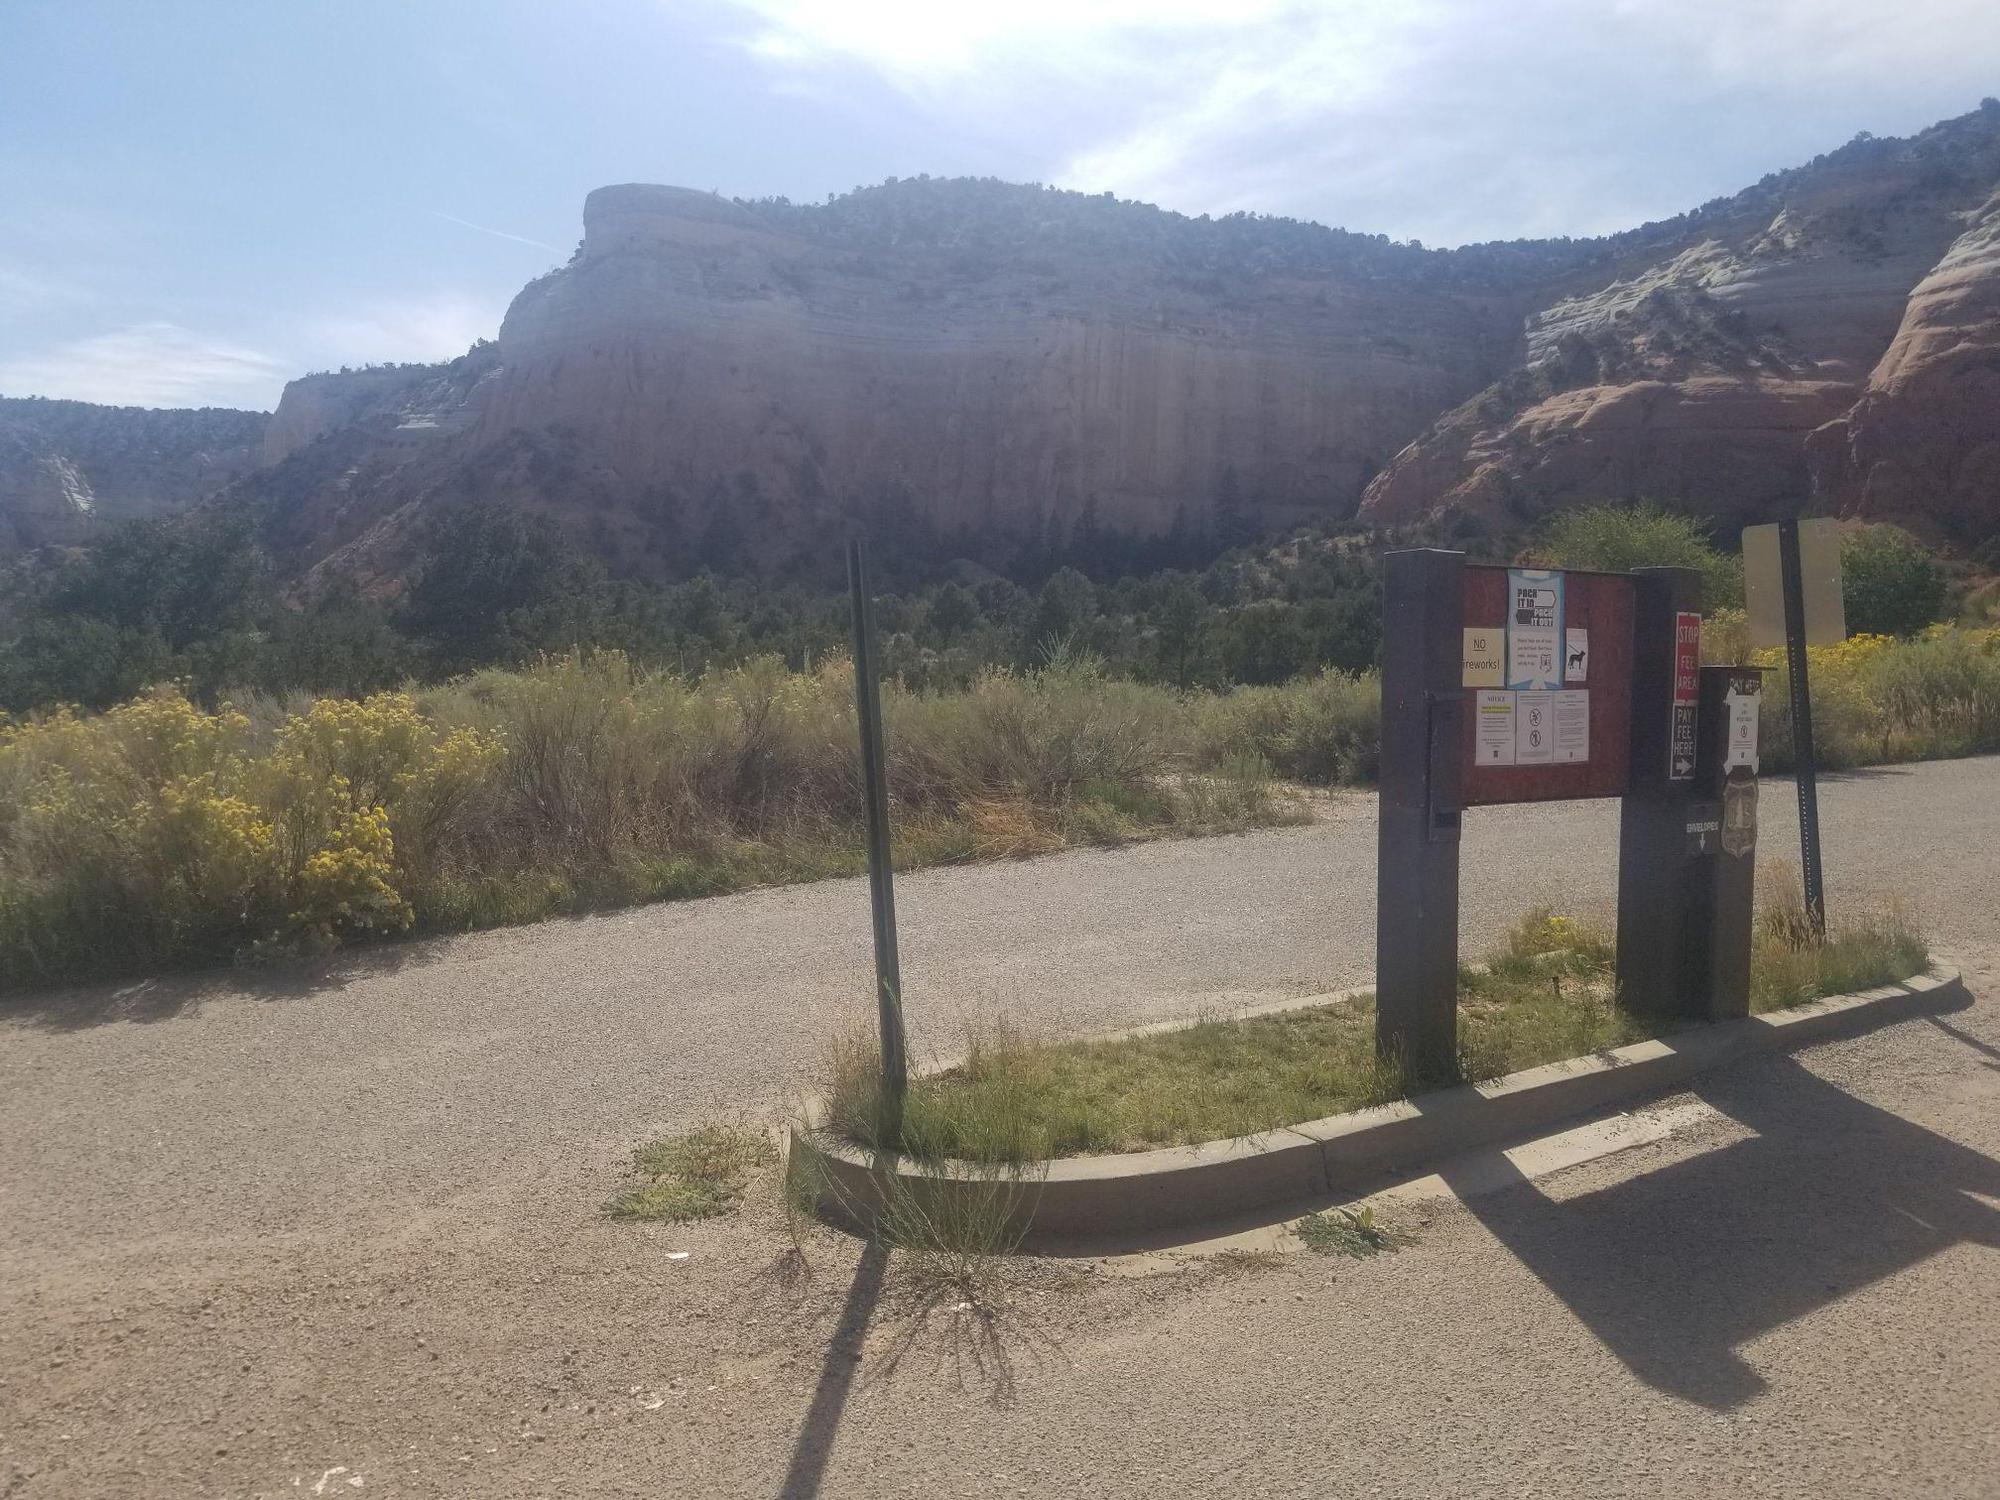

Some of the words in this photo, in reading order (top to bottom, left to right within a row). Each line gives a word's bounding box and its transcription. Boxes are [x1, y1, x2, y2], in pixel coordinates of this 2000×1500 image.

[1517, 588, 1537, 598] PACK
[1517, 598, 1525, 608] IT
[1539, 617, 1553, 626] OUT
[1679, 626, 1698, 643] STOP
[1473, 639, 1486, 650] NO
[1680, 656, 1695, 670] FEE
[1678, 676, 1697, 690] AREA
[1677, 708, 1693, 723] PAY
[1677, 725, 1692, 739] FEE
[1674, 741, 1694, 756] HERE
[1686, 821, 1719, 833] ENVELOPES
